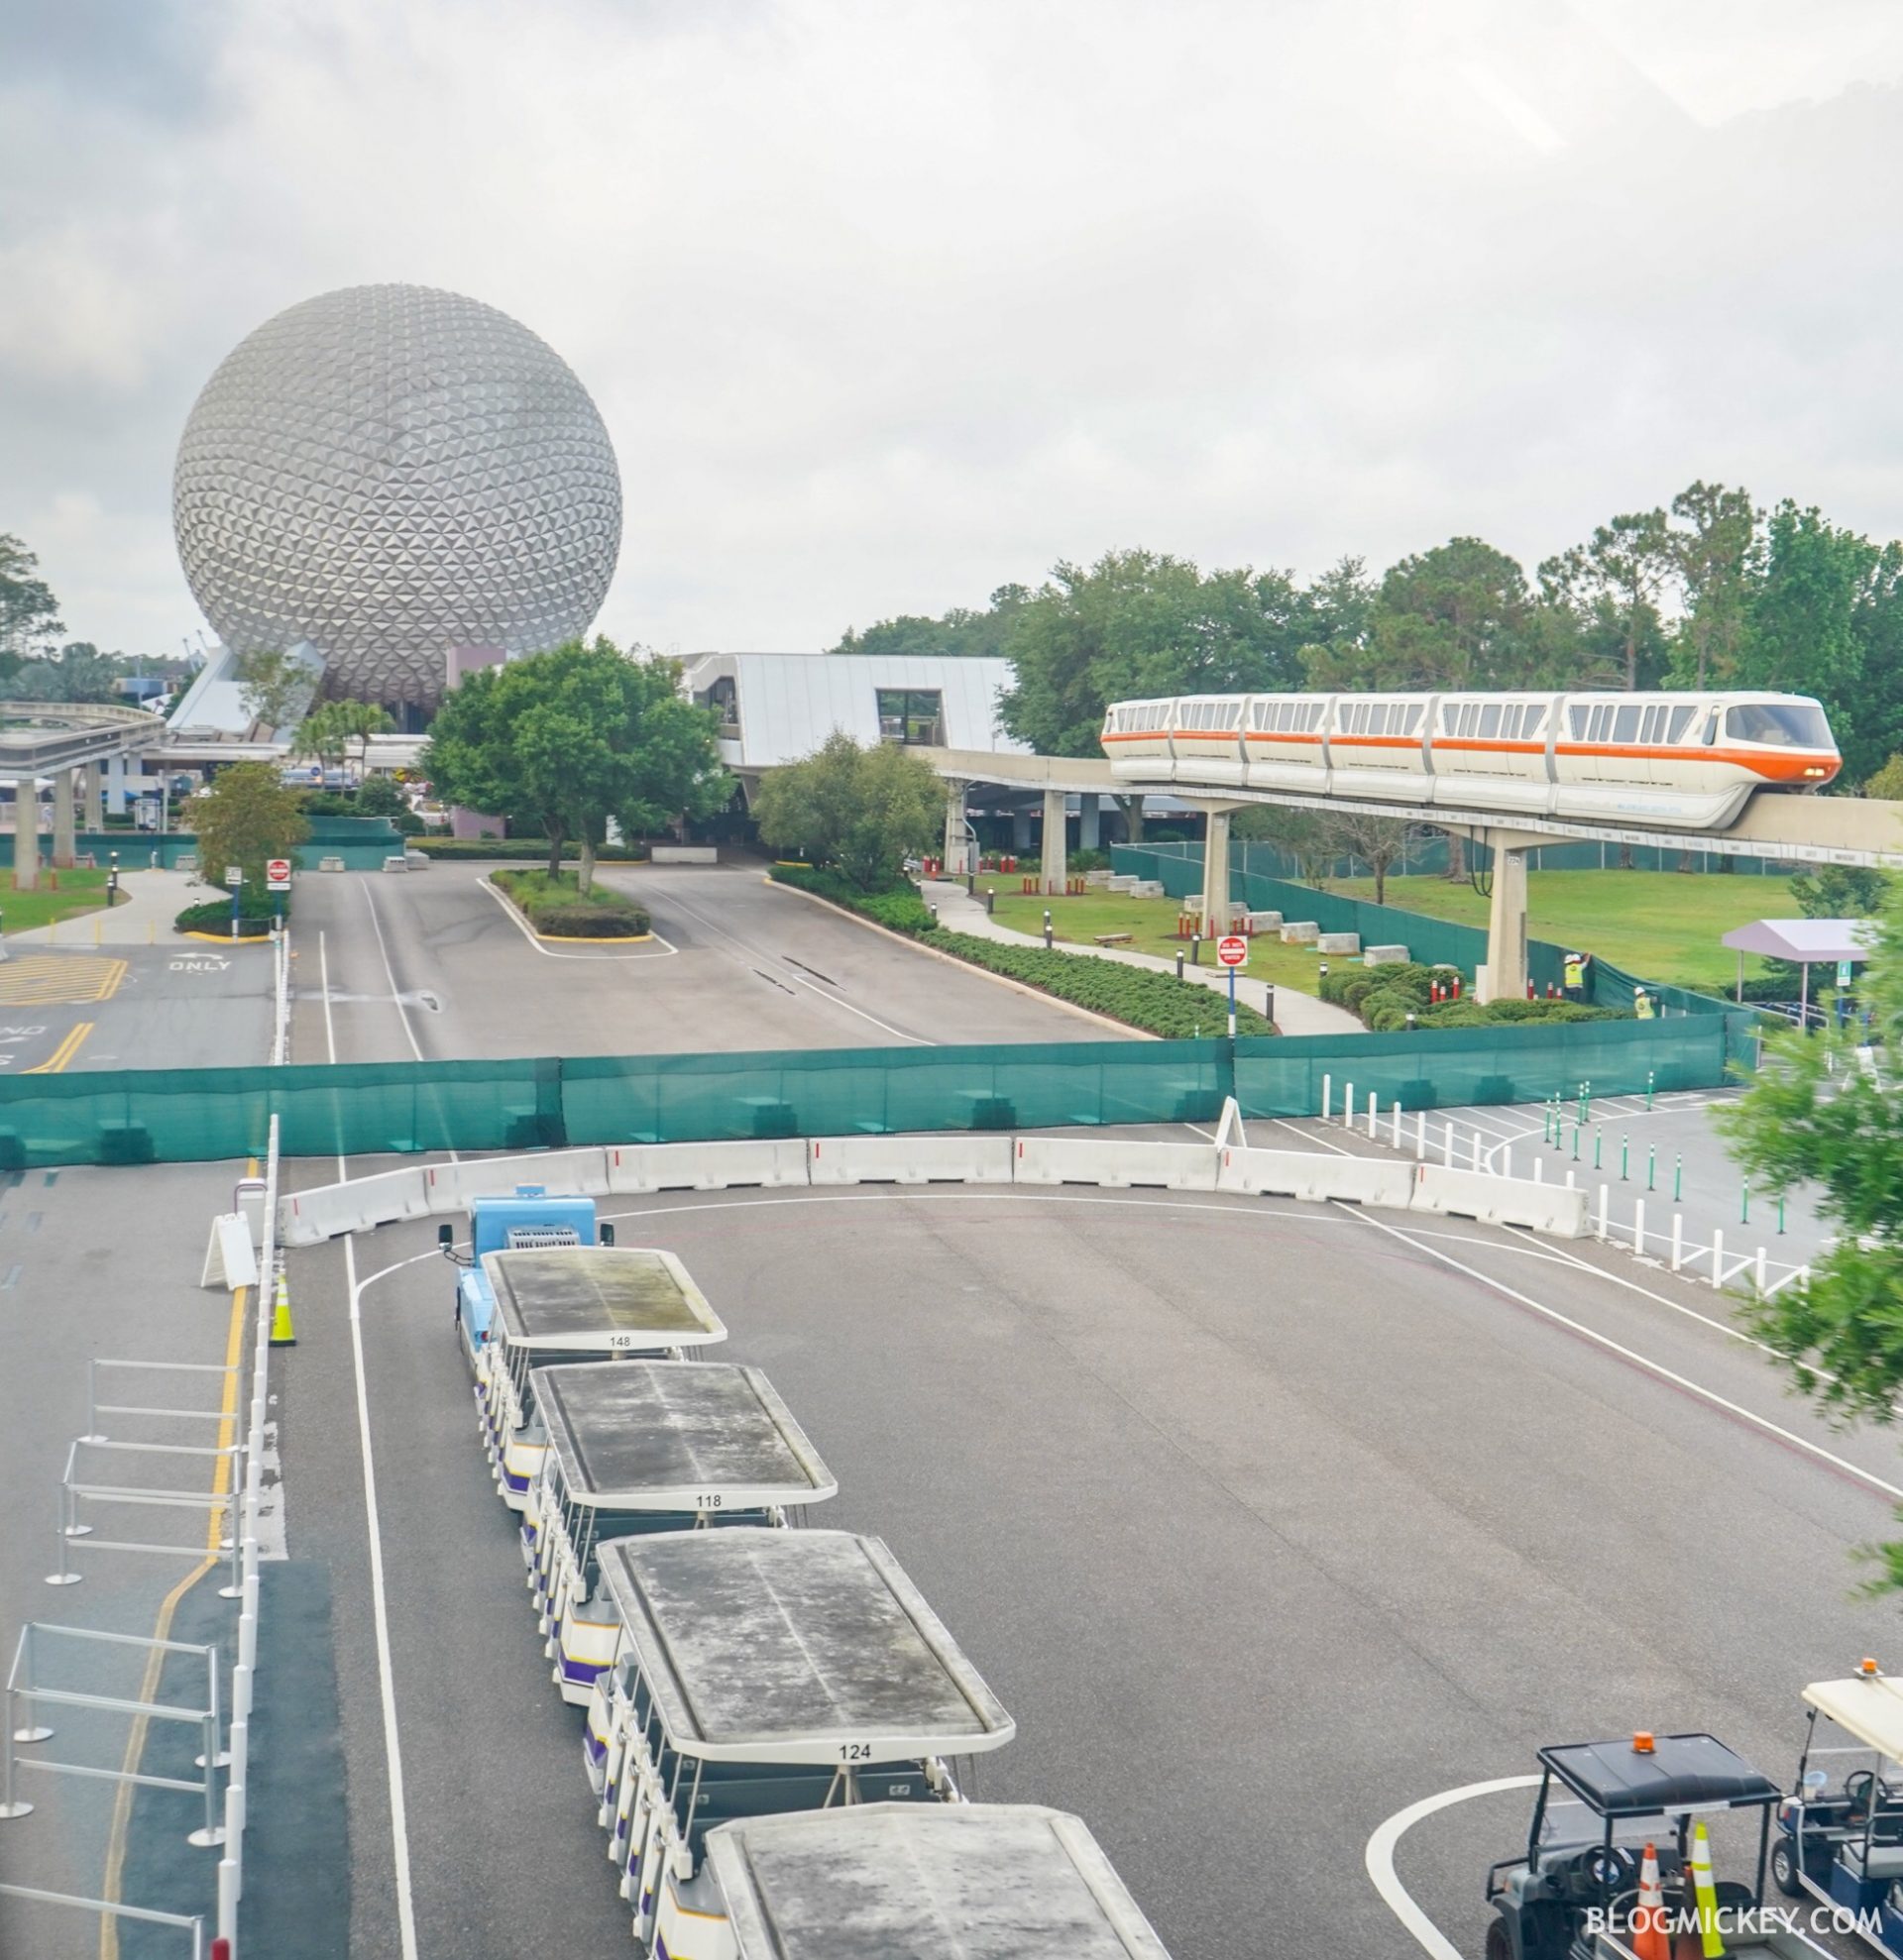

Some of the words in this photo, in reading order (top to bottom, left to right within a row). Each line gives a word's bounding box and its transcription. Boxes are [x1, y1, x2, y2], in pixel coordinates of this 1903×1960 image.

[168, 960, 232, 971] ONLY
[610, 1336, 631, 1347] 148
[696, 1494, 722, 1507] 118
[839, 1743, 871, 1760] 124
